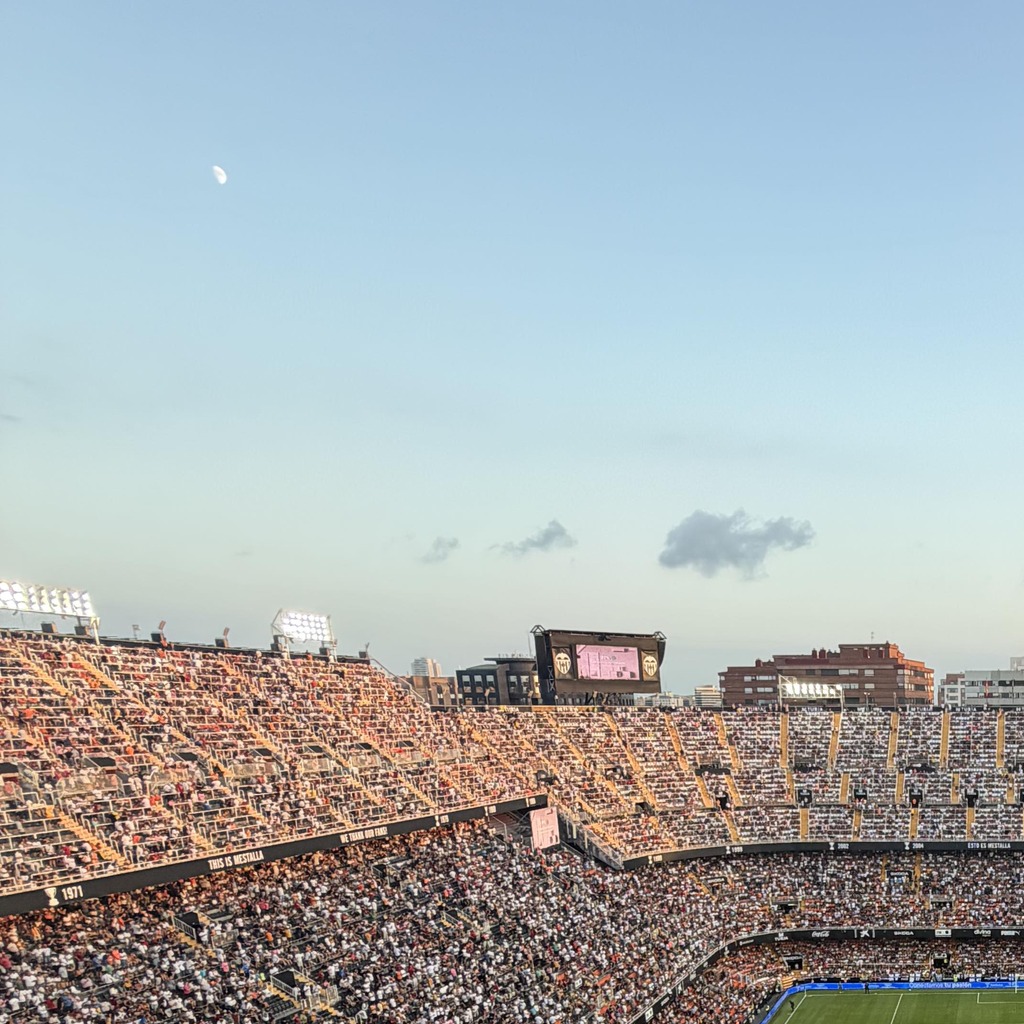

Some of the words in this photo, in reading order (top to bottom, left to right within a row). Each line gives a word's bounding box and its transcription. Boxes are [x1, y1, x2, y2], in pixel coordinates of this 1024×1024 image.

[208, 857, 224, 870] THIS
[225, 855, 233, 867] IS
[234, 850, 265, 865] MESTALLA
[62, 885, 84, 900] 1971
